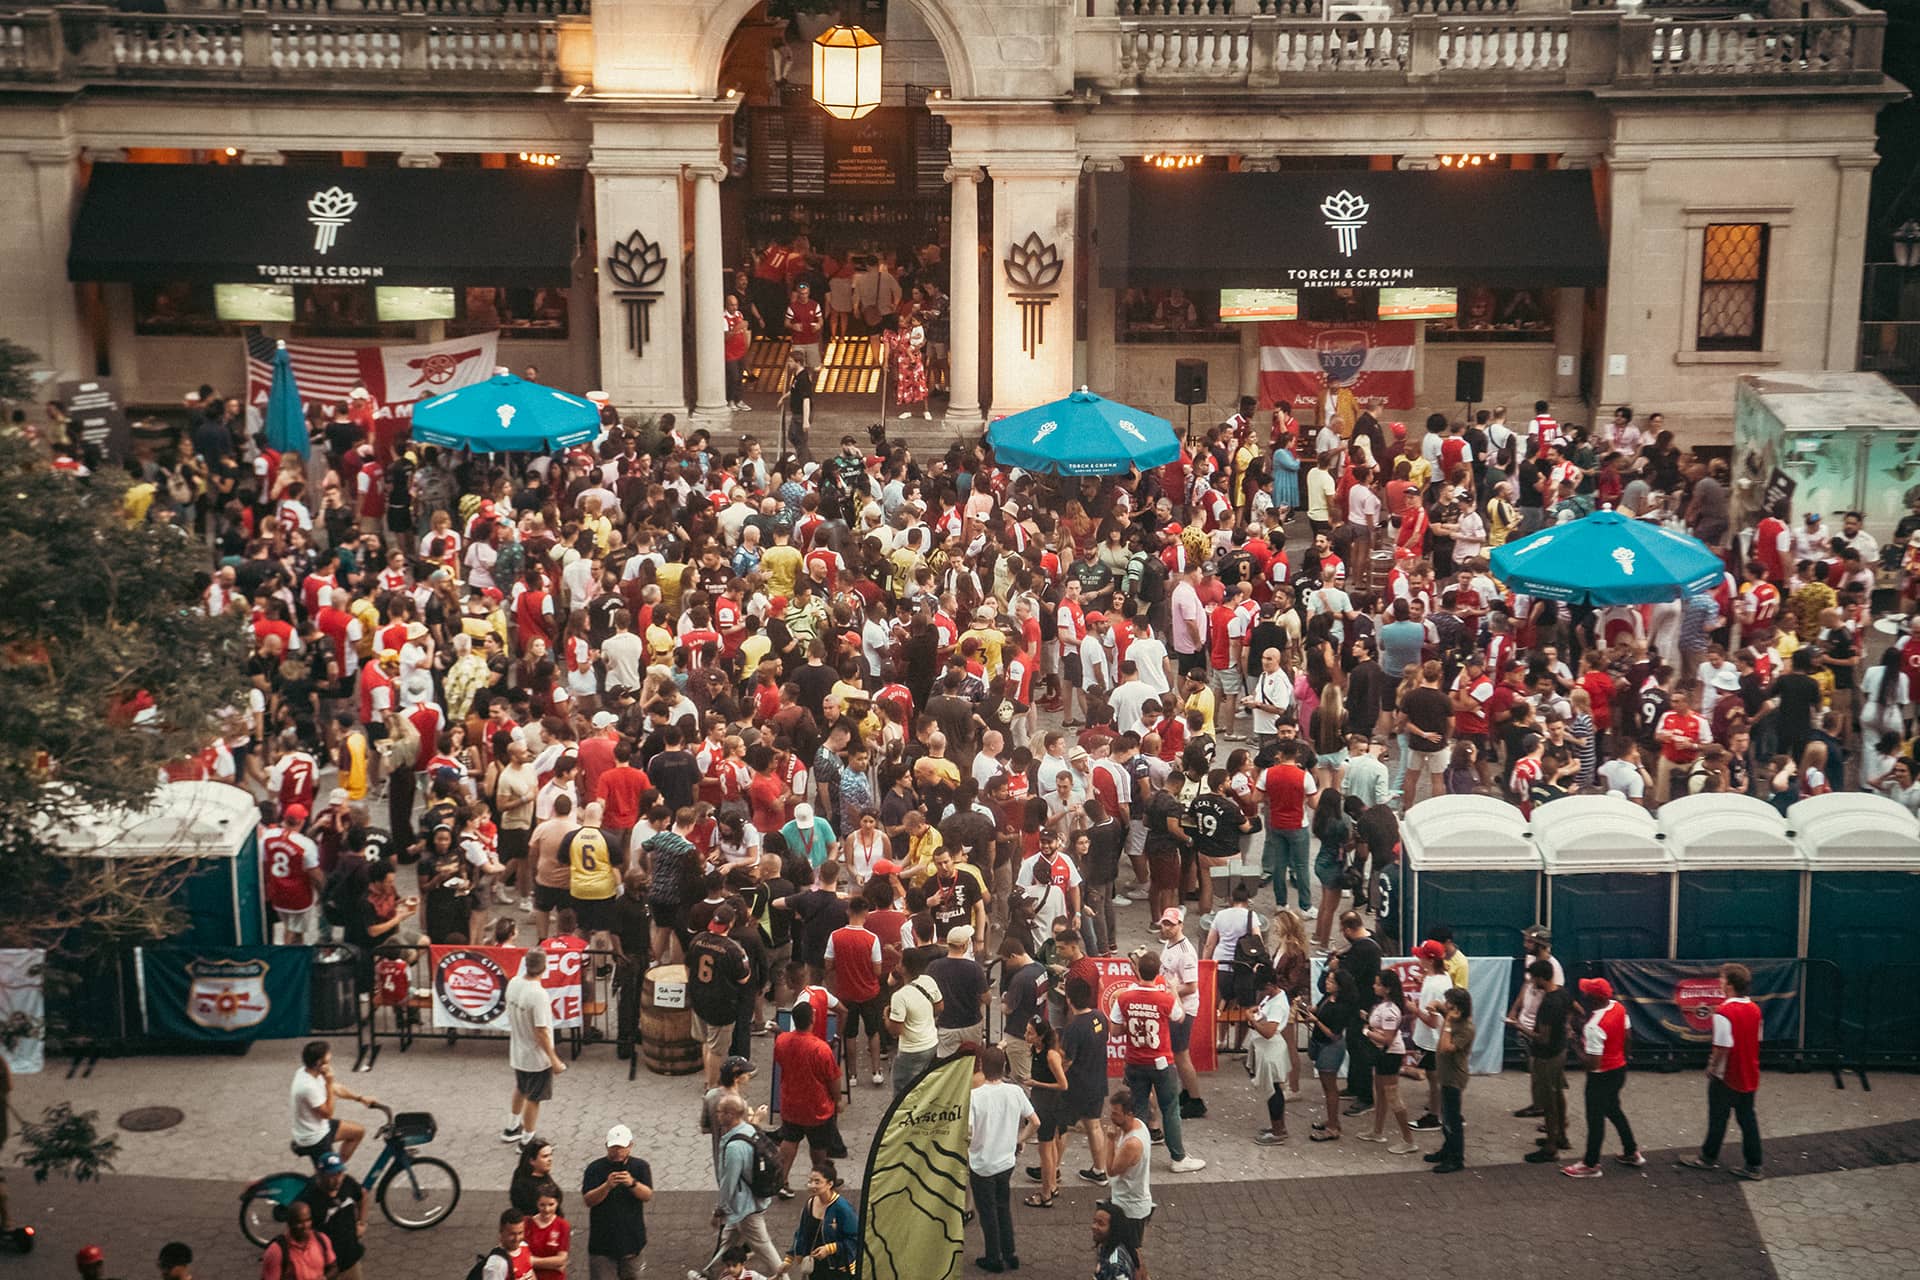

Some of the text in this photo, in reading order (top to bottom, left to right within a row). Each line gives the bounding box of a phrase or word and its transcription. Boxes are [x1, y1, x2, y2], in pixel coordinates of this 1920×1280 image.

[257, 265, 383, 277] TORCH & CROWN
[1288, 268, 1414, 280] TORCH & CROWN
[1323, 354, 1361, 367] NYC
[1643, 703, 1656, 724] 9
[1197, 813, 1217, 837] 19
[272, 852, 289, 878] 8
[582, 844, 598, 871] 6
[481, 958, 504, 976] CITY
[698, 954, 714, 983] 6
[1127, 1010, 1160, 1020] WINNERS
[1129, 1003, 1158, 1012] DOUBLE
[898, 1104, 962, 1127] Arsenal
